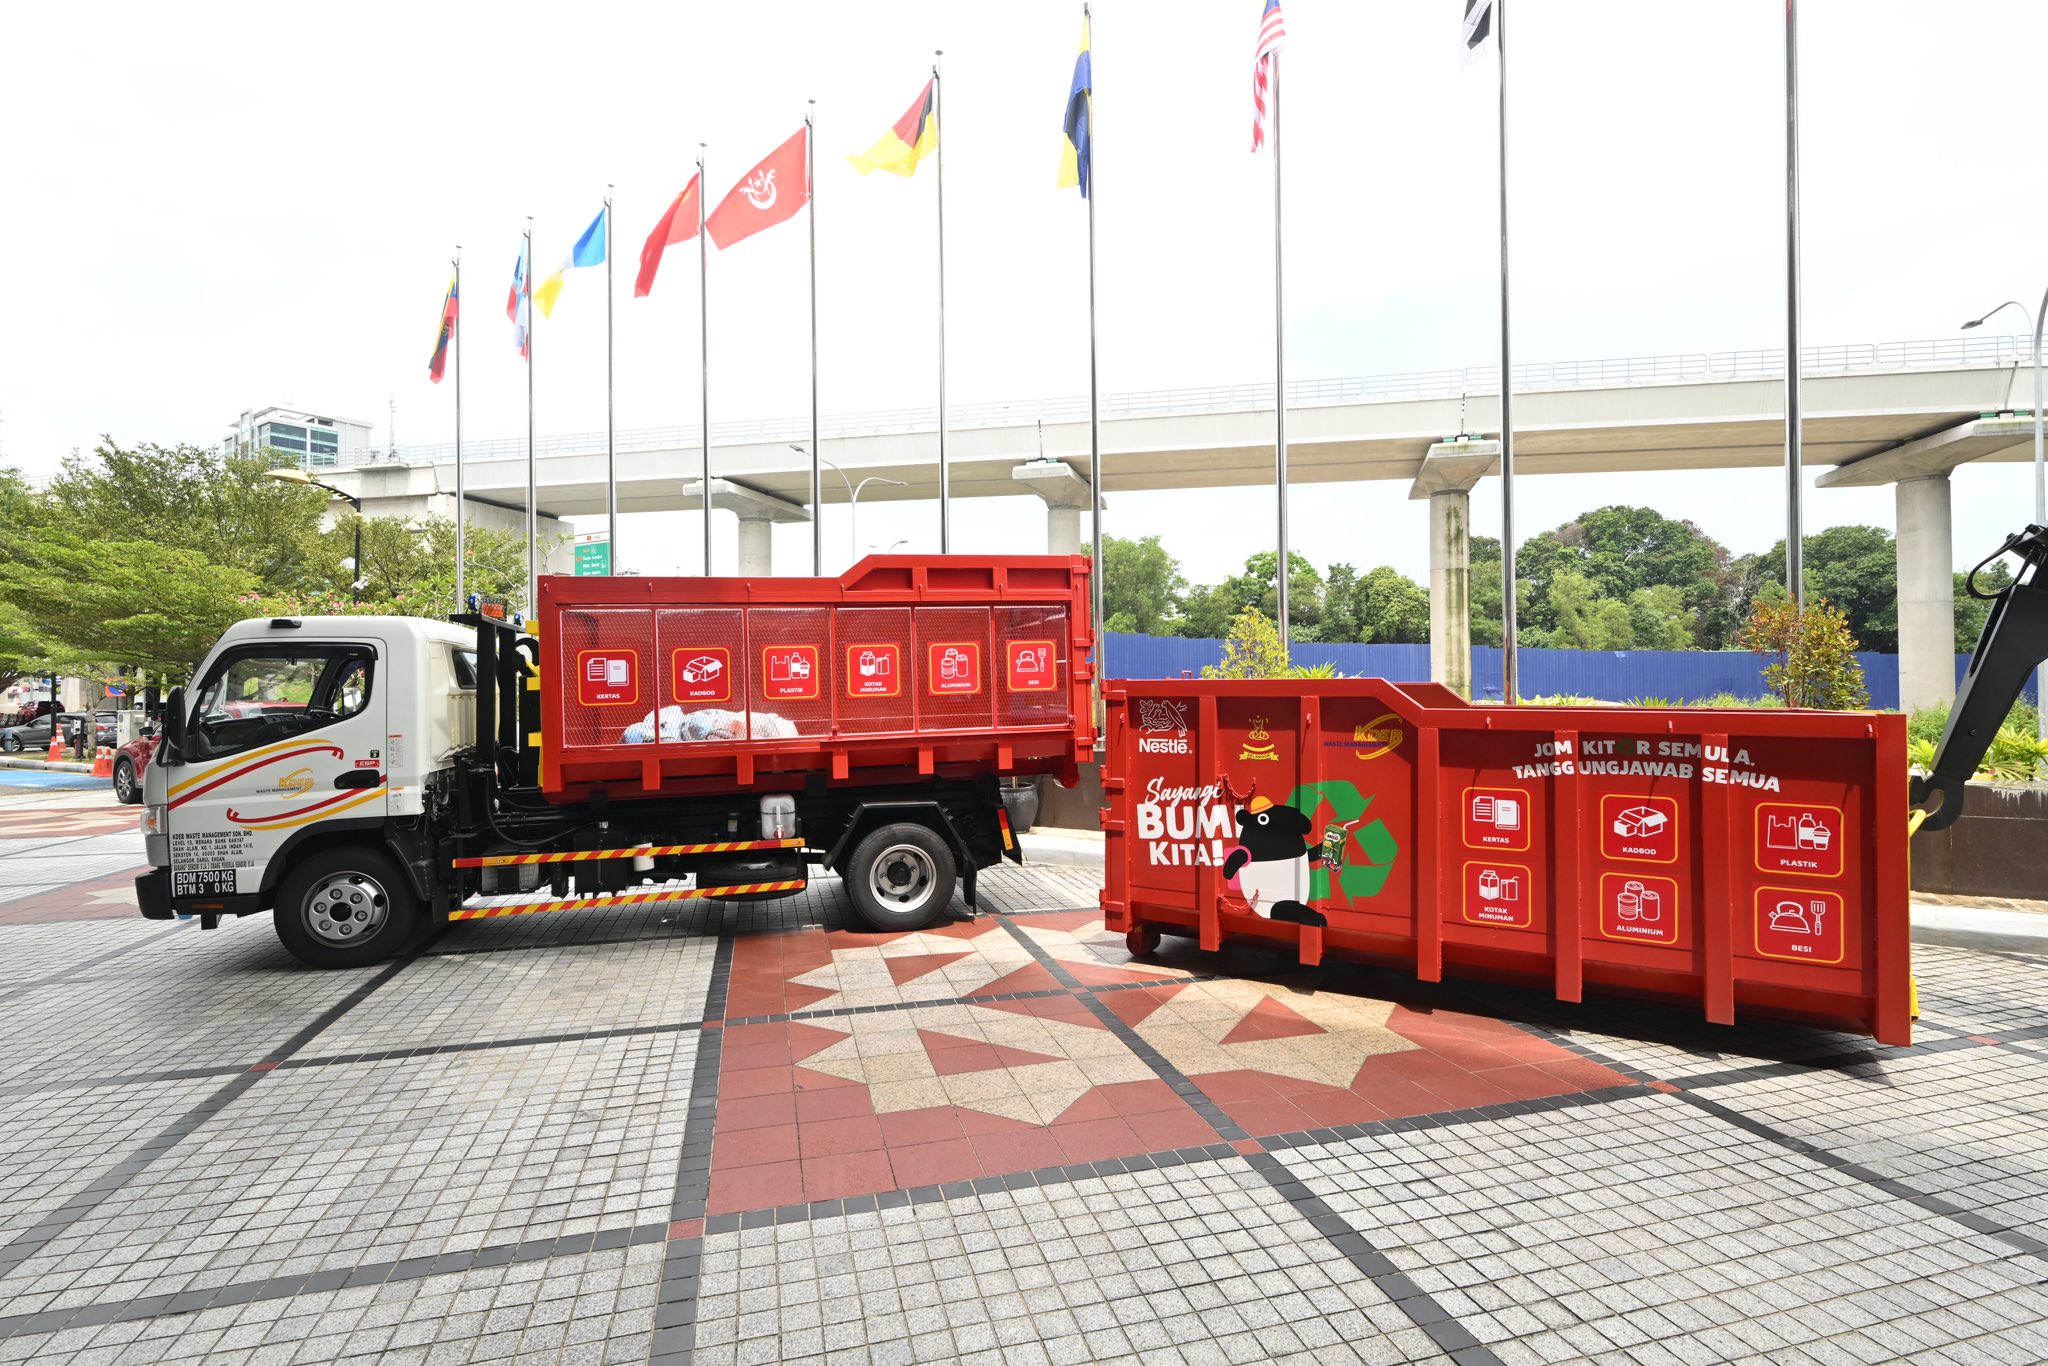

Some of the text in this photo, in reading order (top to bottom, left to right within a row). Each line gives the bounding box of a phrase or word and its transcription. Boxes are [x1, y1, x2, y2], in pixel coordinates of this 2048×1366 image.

[1354, 726, 1404, 744] KDEB
[1534, 740, 1572, 757] JOM
[1512, 760, 1780, 792] TANGGUNGJAWAB SEMUA
[1145, 776, 1225, 807] Sayangi
[1149, 840, 1225, 866] KITA!
[1622, 847, 1656, 855] KADBOD
[1780, 859, 1818, 868] PLASTIK
[177, 870, 234, 884] BDM 7500 KG
[177, 884, 196, 895] BTM
[222, 882, 234, 892] KG
[1478, 913, 1514, 922] MINUMAN
[1616, 925, 1664, 936] ALUMINIUM
